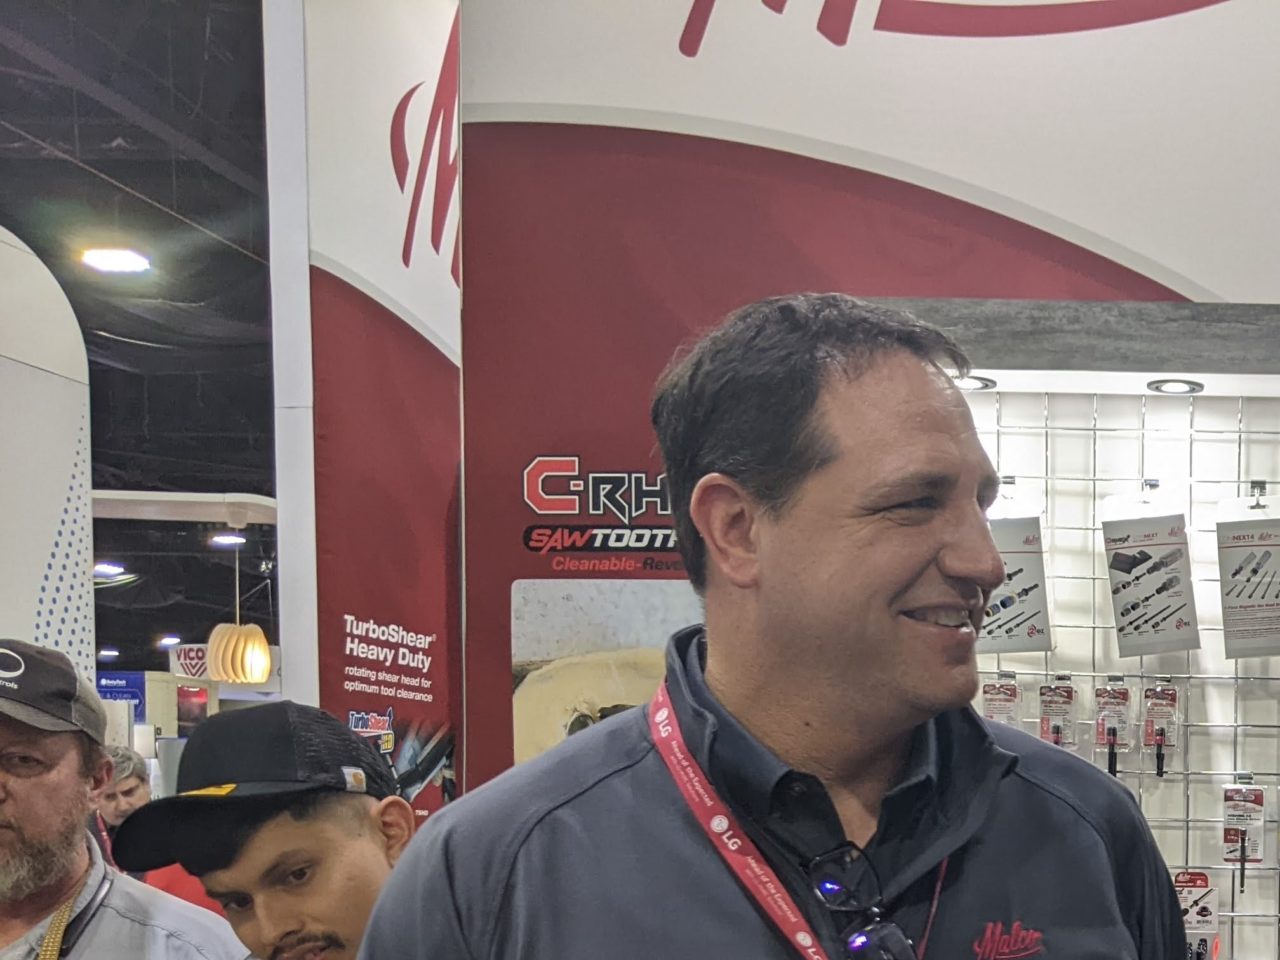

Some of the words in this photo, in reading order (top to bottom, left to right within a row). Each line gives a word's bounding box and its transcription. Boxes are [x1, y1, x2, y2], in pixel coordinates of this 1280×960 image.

[176, 647, 208, 661] VICO
[346, 637, 395, 666] Heavy
[398, 647, 432, 673] Duty
[345, 666, 377, 681] rotating
[378, 671, 400, 682] shear
[401, 674, 420, 686] head
[421, 677, 432, 688] for
[344, 681, 379, 693] optimum
[380, 685, 395, 696] tool
[396, 688, 433, 702] clearance
[659, 720, 672, 738] LG
[722, 831, 742, 850] LG
